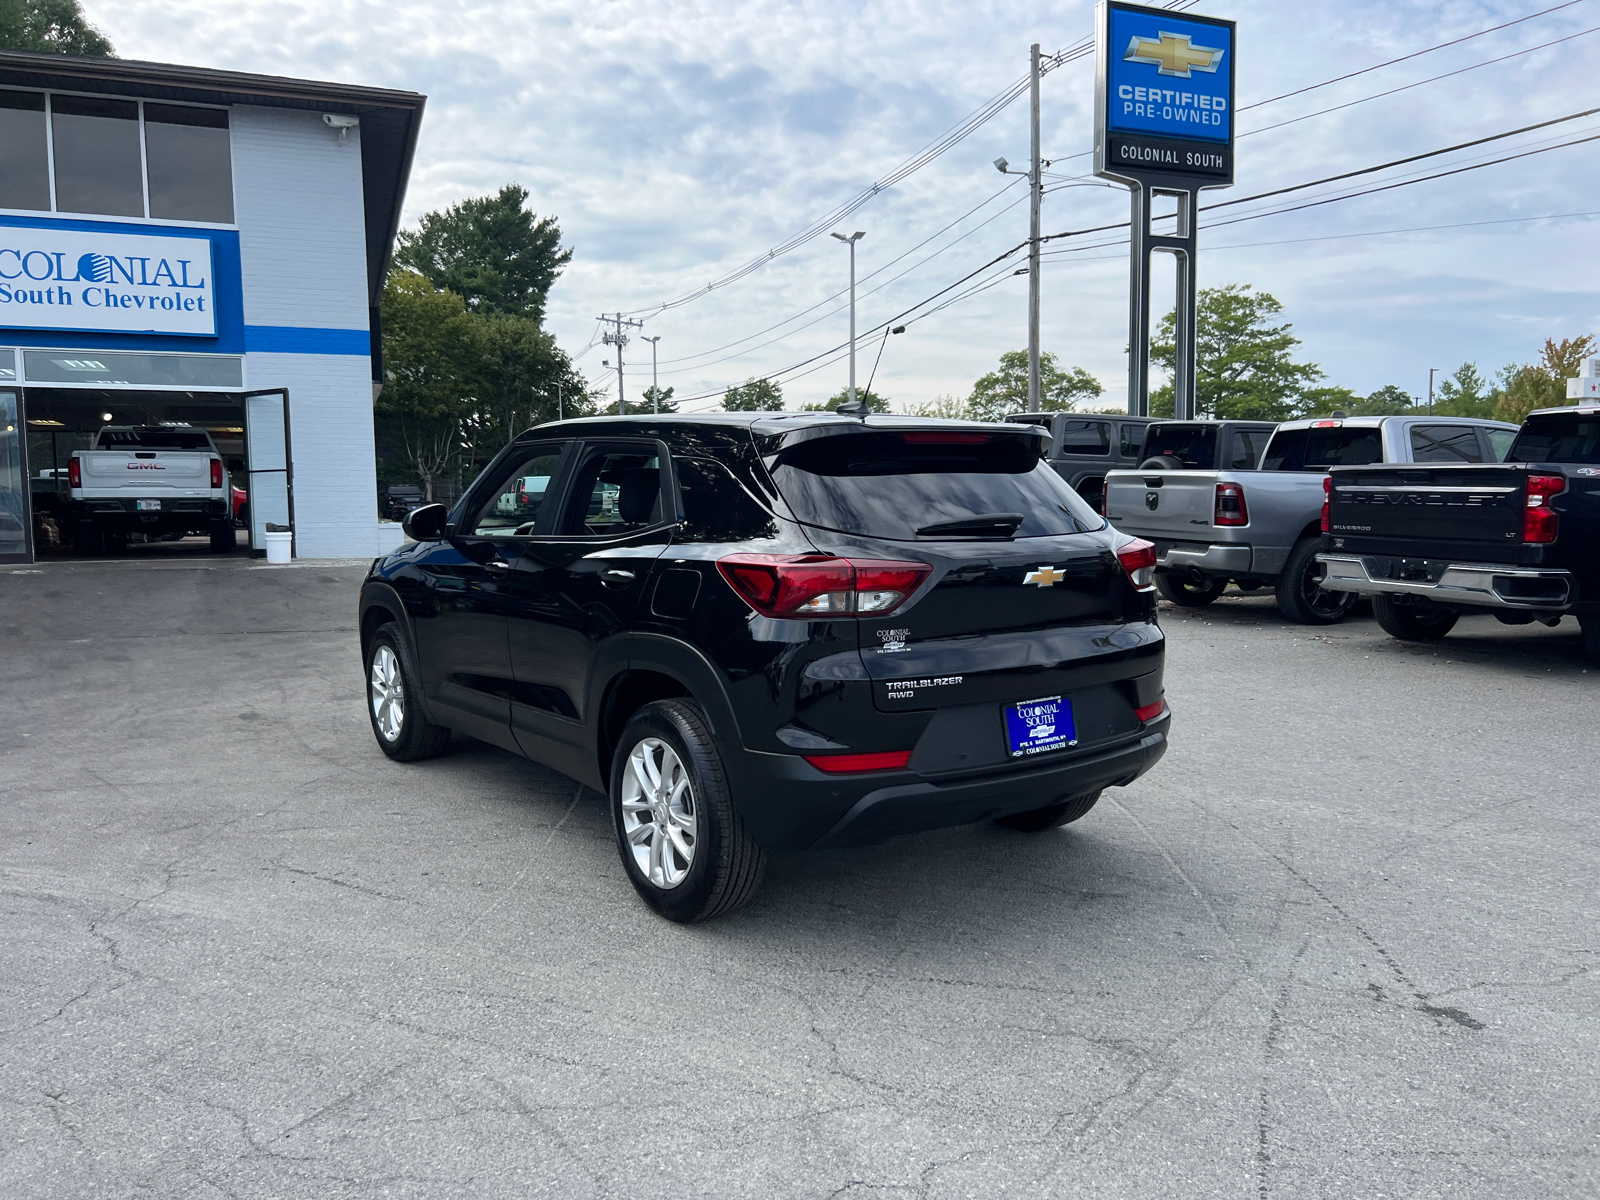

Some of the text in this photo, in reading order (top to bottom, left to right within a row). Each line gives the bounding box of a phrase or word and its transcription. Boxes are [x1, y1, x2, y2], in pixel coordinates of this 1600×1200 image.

[1118, 84, 1227, 111] CERTIFIED
[1123, 101, 1221, 126] PRE-OWNED
[1120, 145, 1223, 168] COLONIAL SOUTH
[0, 249, 205, 289] COLONIAL
[0, 282, 206, 312] South Chevrolet
[127, 462, 166, 470] GMC
[876, 628, 911, 638] COLONIAL
[881, 635, 906, 643] SOUTH
[885, 676, 963, 690] TRAILBLAZER
[888, 691, 914, 699] AWD
[1018, 703, 1060, 719] COLONIAL
[1026, 713, 1055, 728] SOUTH
[1031, 727, 1053, 736] CHEVROLET
[1026, 741, 1066, 755] COLONIAL SOUTH
